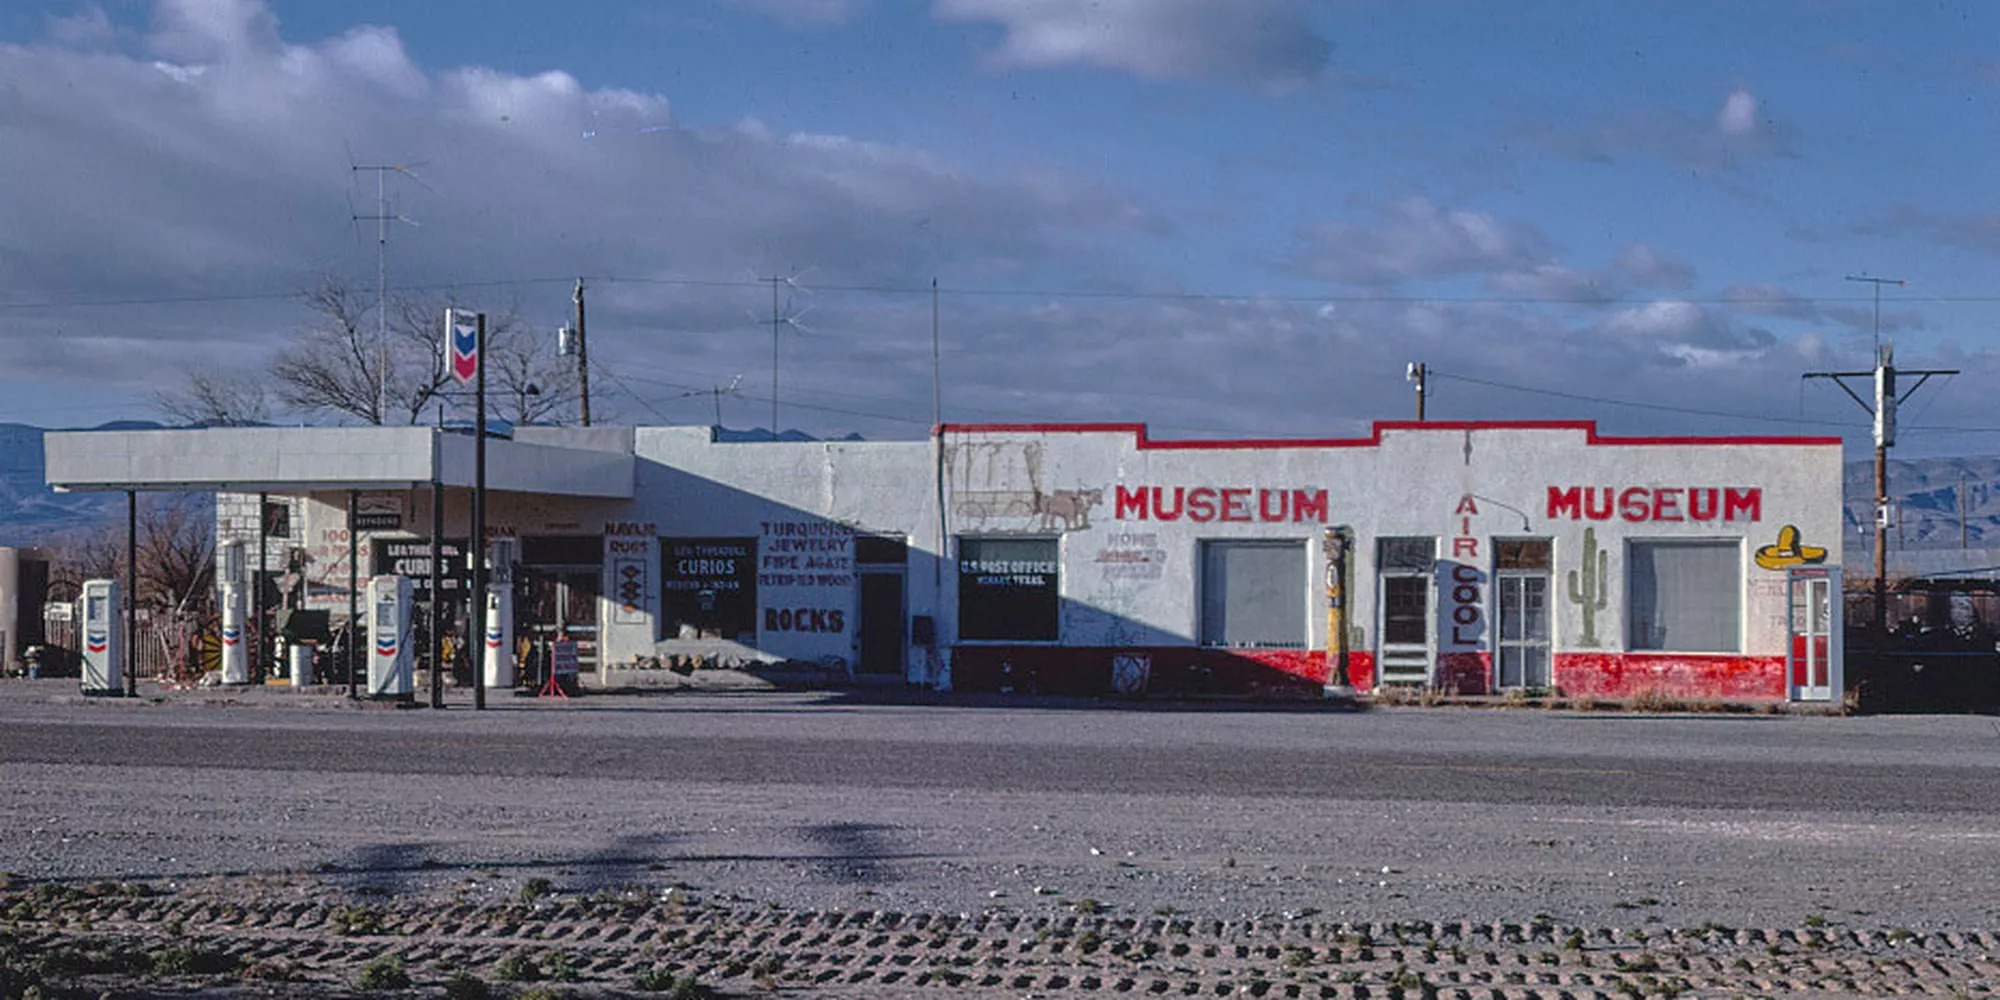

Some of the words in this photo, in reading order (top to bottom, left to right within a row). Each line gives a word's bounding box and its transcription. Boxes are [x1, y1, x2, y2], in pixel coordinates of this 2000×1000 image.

[1115, 485, 1329, 523] MUSEUM
[1547, 486, 1763, 523] MUSEUM
[1454, 495, 1478, 557] AIR
[768, 538, 848, 552] JEWELRY
[395, 559, 449, 575] CURIS
[678, 559, 736, 575] CURIOS
[980, 560, 1009, 573] POST
[1011, 560, 1057, 573] OFFICE
[1452, 565, 1479, 645] COOL
[765, 608, 845, 632] ROCKS
